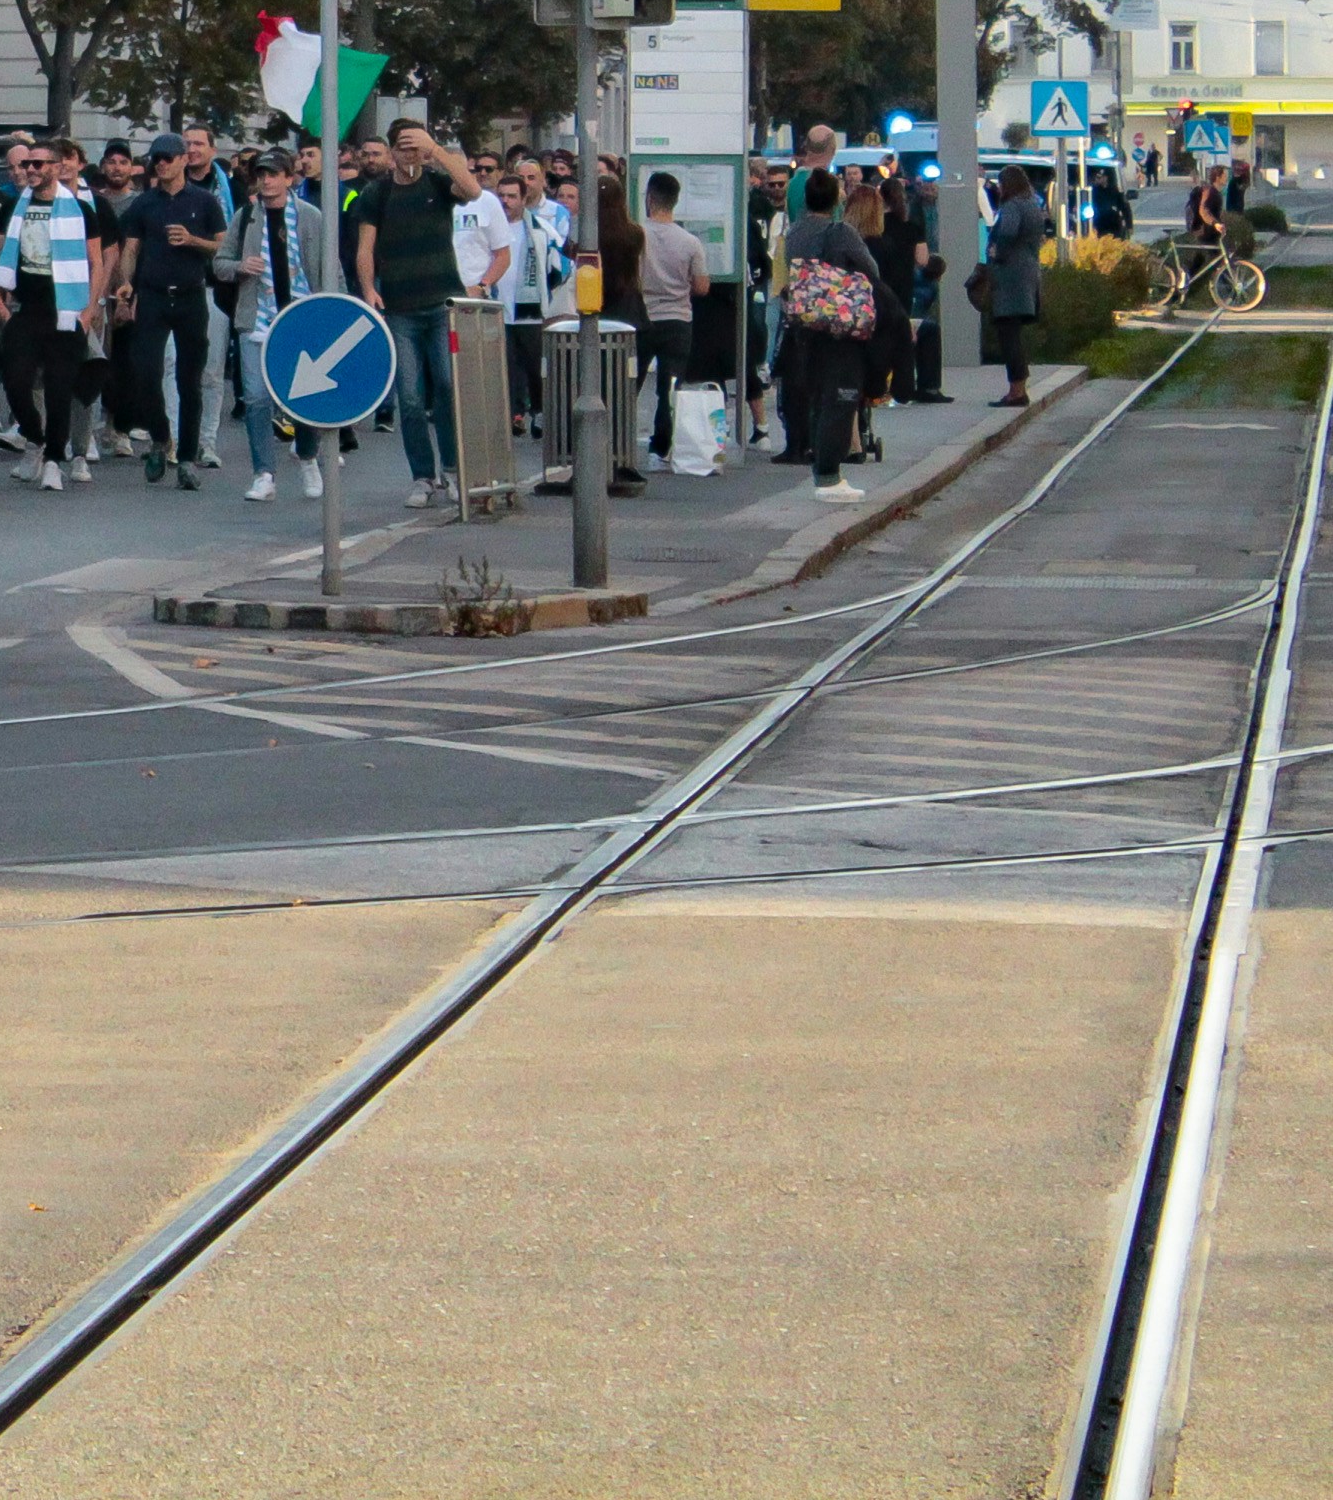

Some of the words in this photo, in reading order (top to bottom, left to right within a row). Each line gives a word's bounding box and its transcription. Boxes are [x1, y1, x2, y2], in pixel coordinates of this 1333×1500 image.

[647, 35, 657, 49] 5
[636, 77, 654, 87] N4
[656, 76, 678, 88] N5
